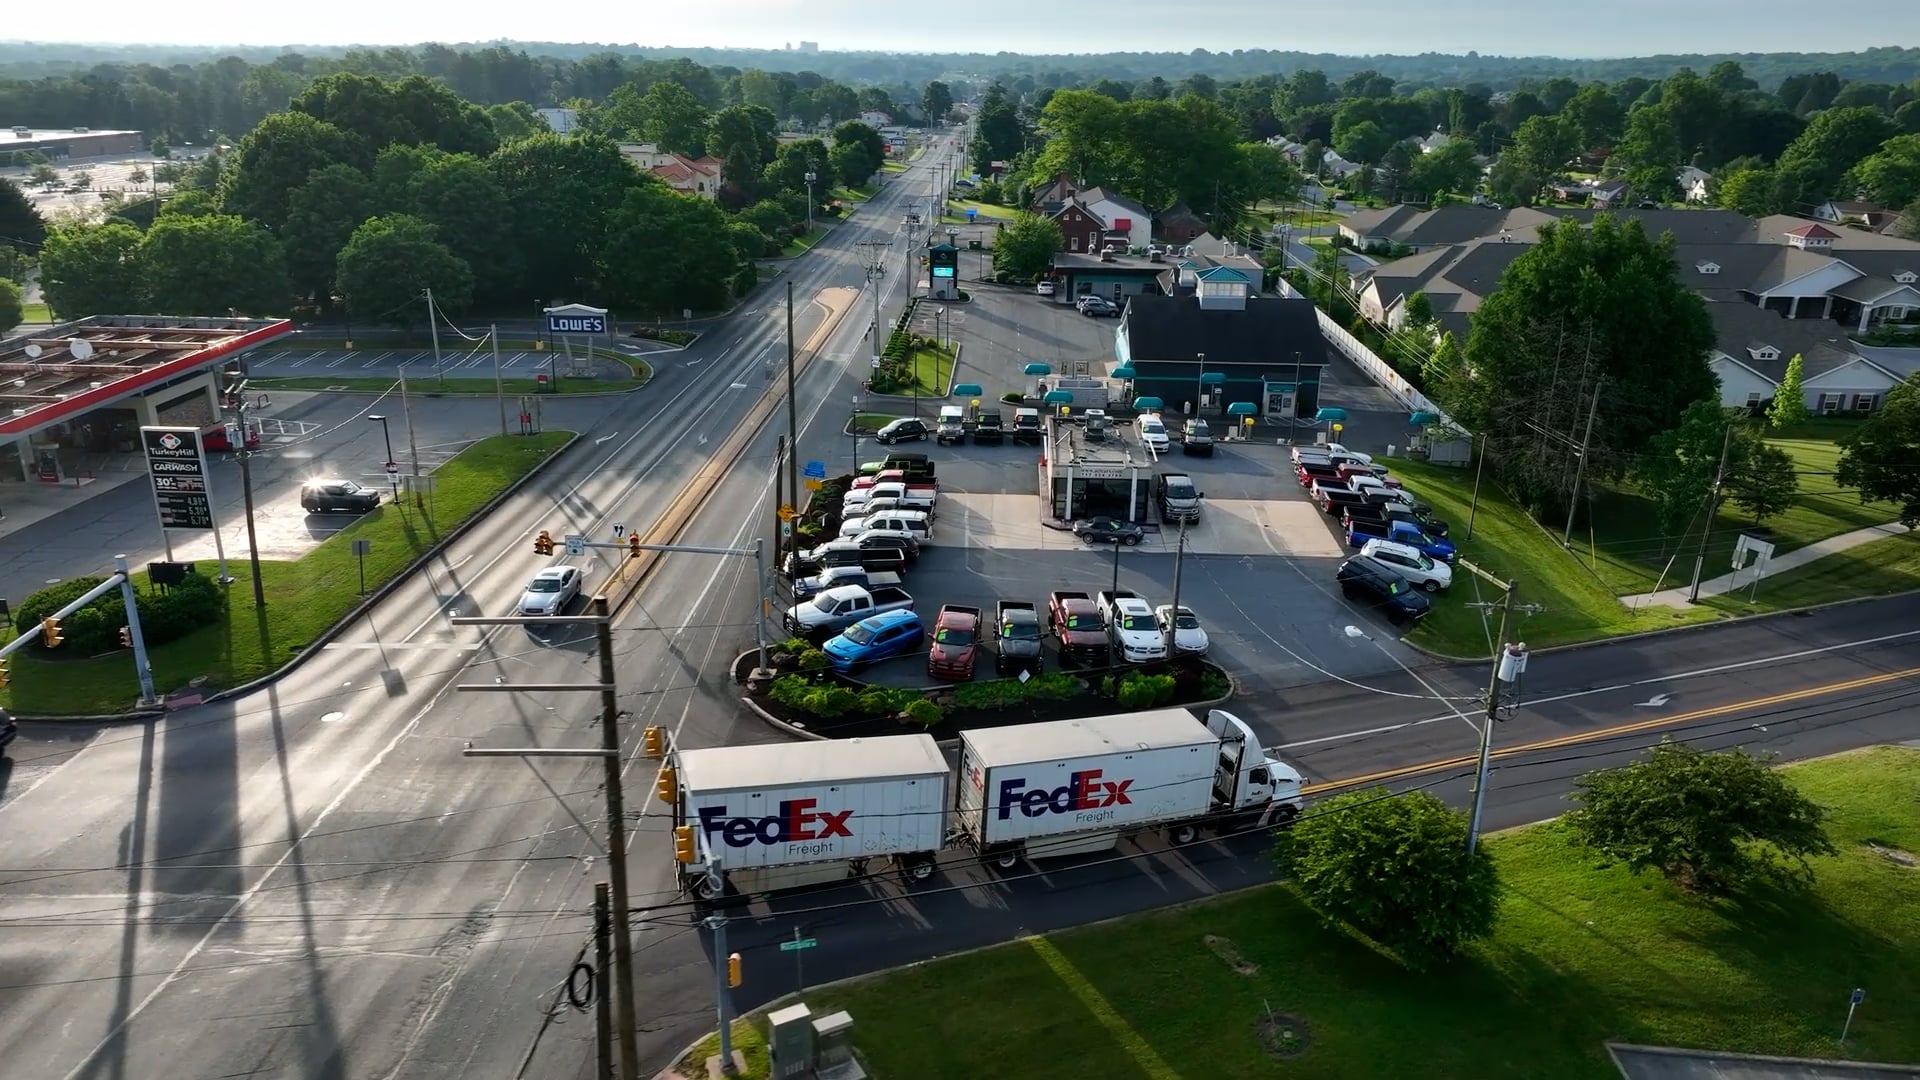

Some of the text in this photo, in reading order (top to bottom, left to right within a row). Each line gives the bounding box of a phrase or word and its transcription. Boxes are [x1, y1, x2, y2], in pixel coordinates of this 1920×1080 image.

[550, 317, 602, 331] LOWE'S
[998, 769, 1134, 820] FedEx
[1075, 810, 1114, 823] Freight
[698, 798, 854, 850] FedEx
[789, 842, 833, 856] Freight
